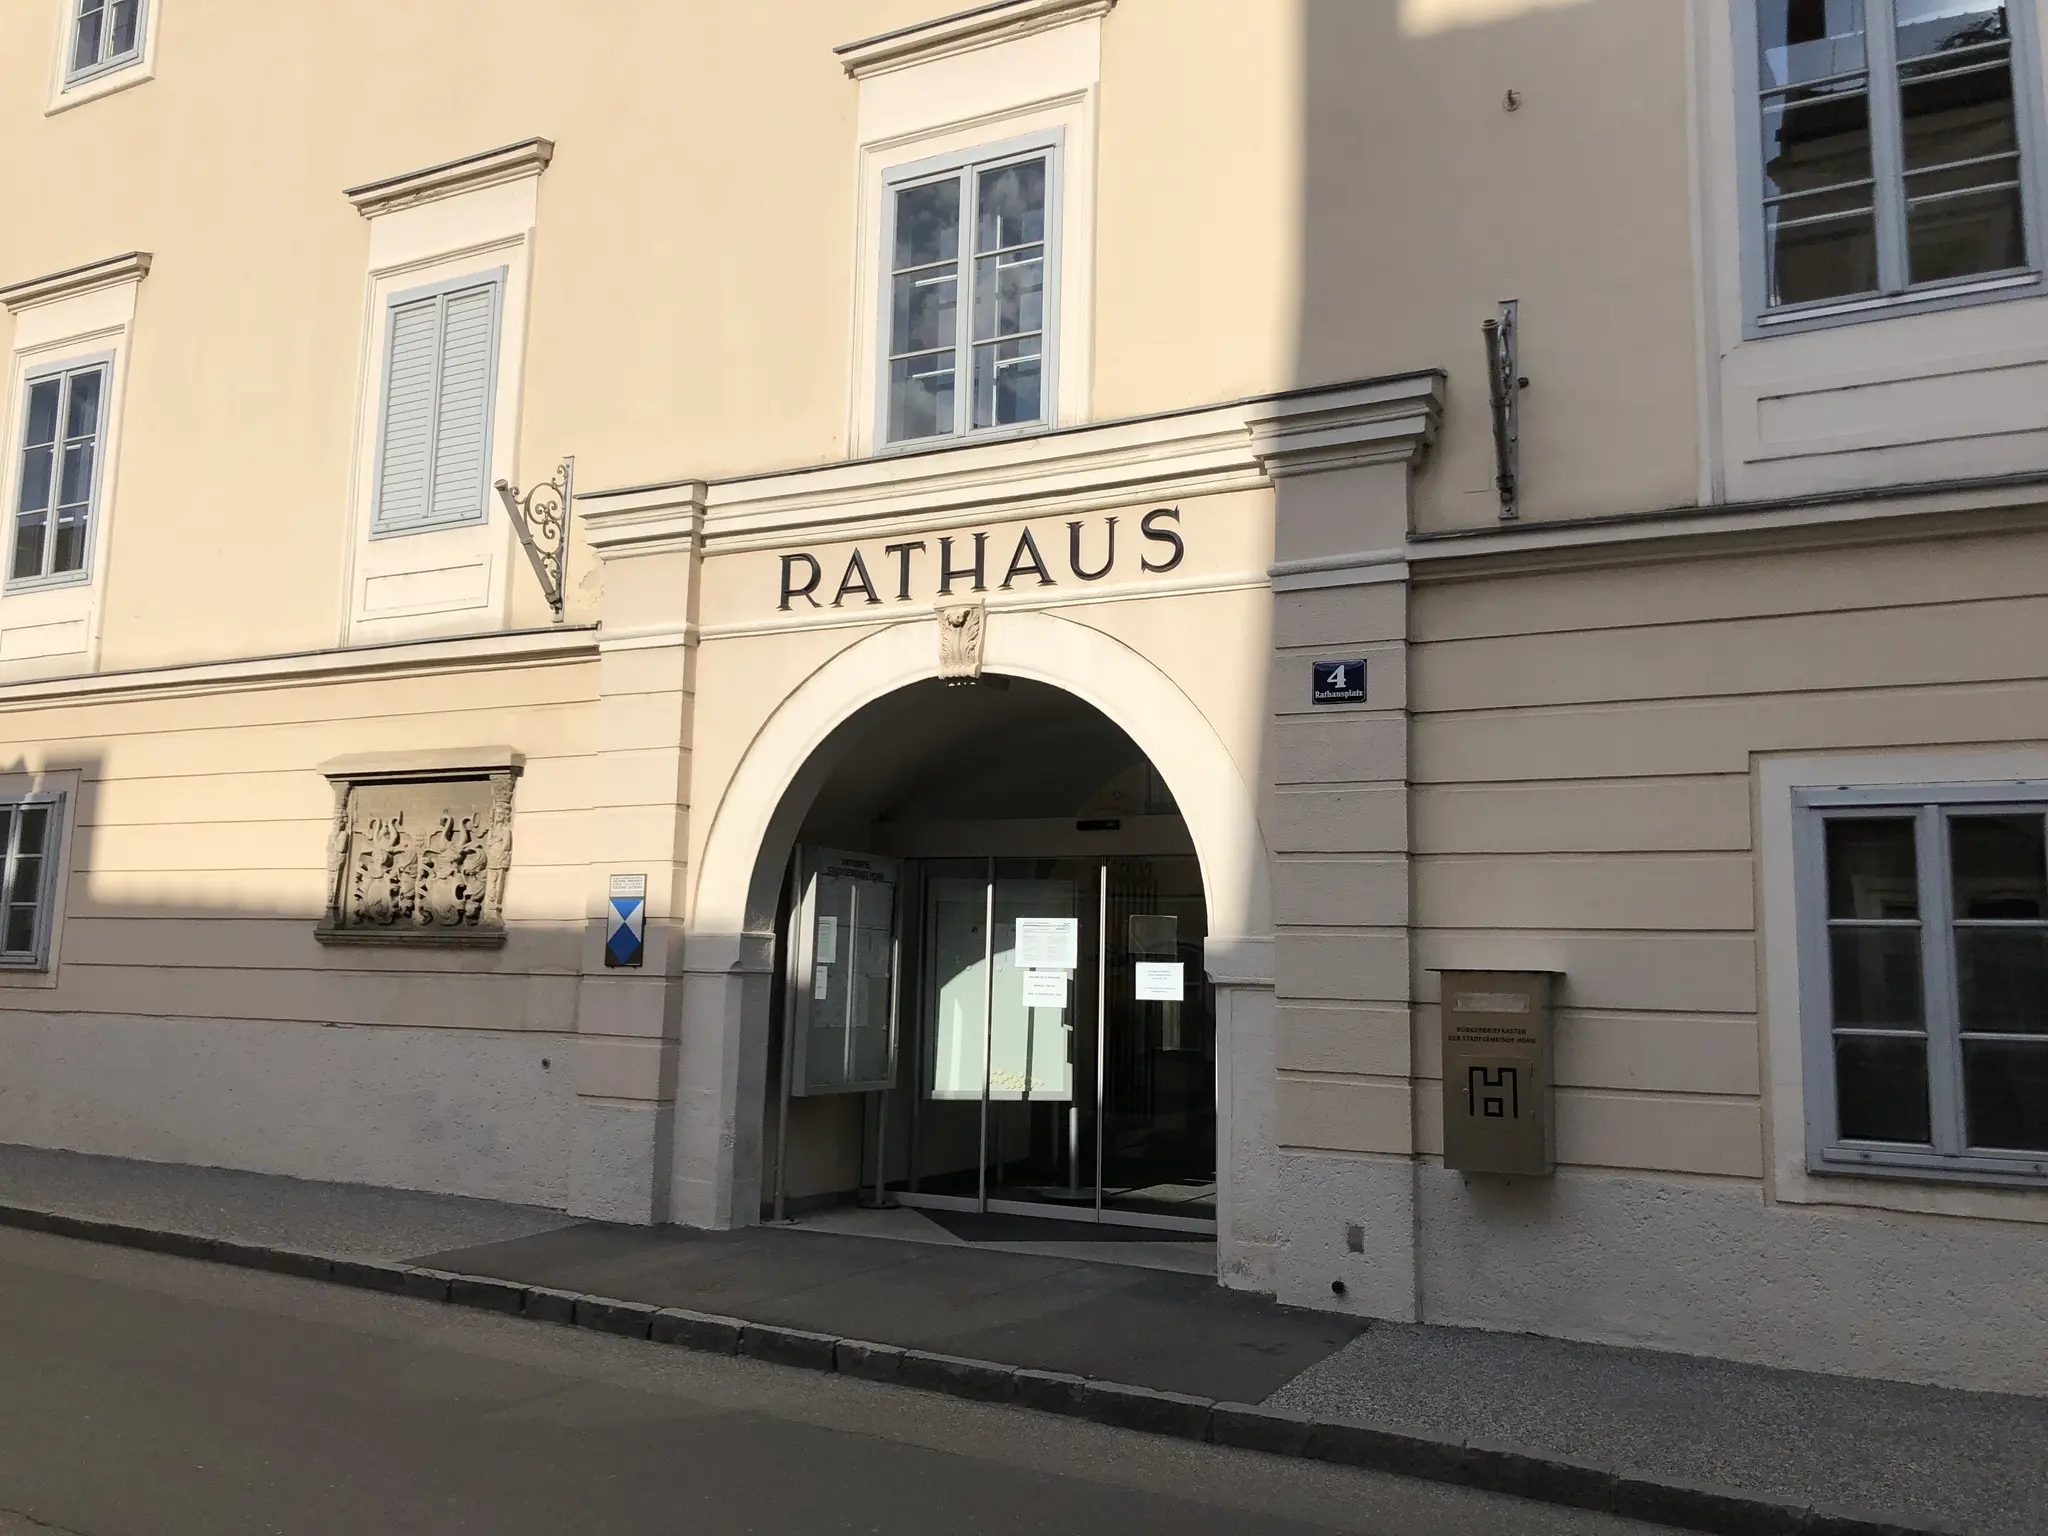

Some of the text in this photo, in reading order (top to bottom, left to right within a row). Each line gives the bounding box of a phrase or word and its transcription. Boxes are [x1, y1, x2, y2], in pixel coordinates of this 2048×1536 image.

[777, 505, 1184, 611] RATHAUS
[1327, 665, 1346, 688] 4
[1315, 690, 1363, 698] Rathausplatz
[1462, 1035, 1515, 1043] STADTGEMEINDE
